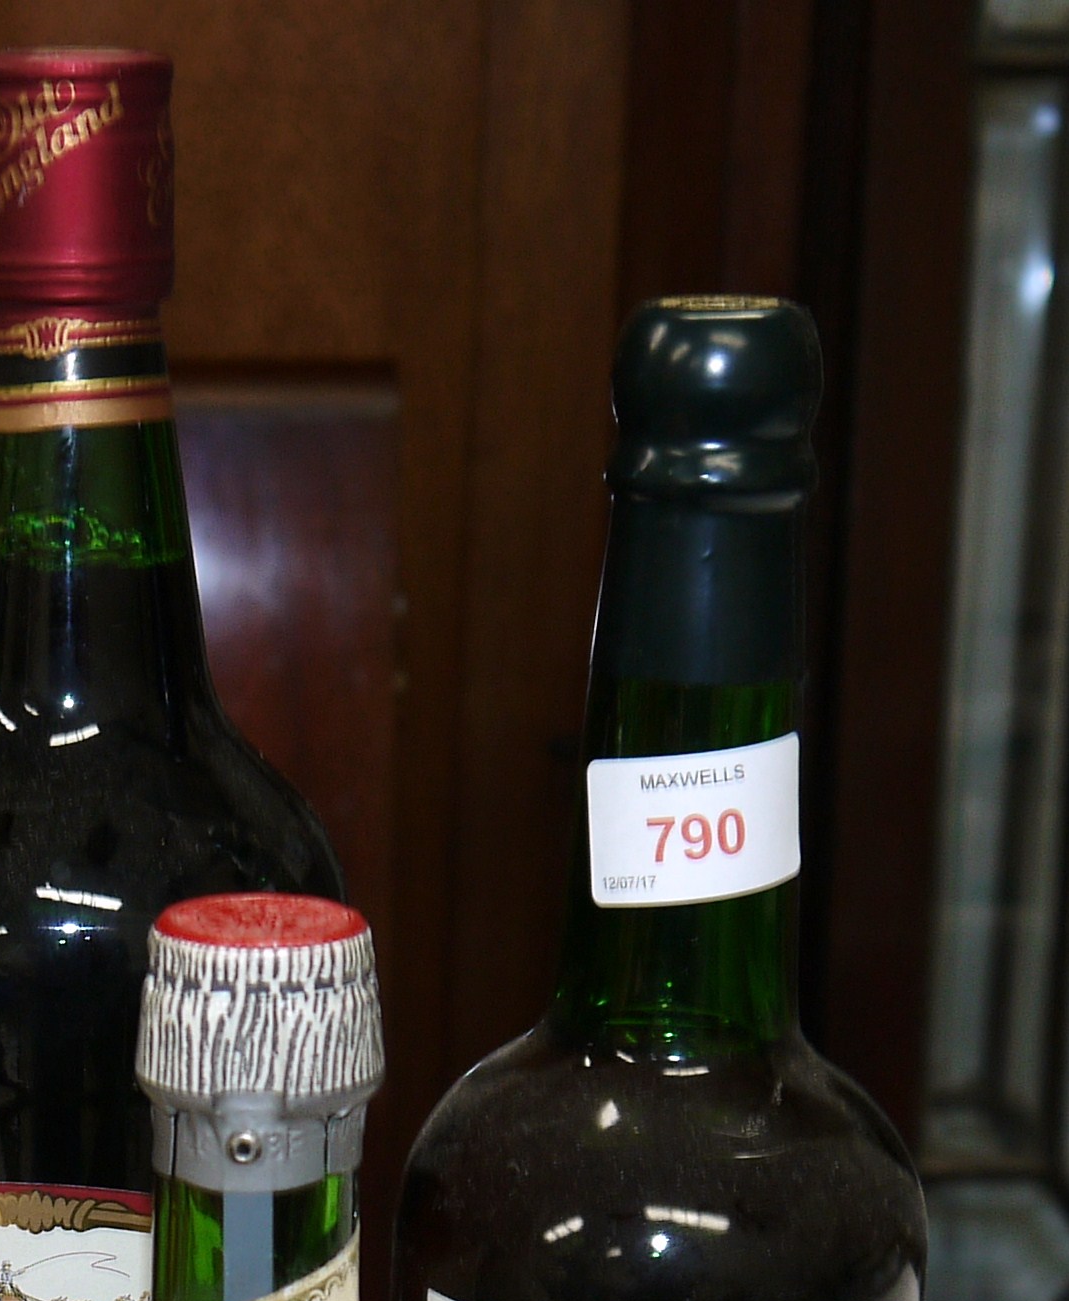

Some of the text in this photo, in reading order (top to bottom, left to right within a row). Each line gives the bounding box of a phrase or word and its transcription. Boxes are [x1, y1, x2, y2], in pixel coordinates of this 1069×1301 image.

[640, 764, 745, 791] MAXWELLS
[646, 808, 746, 863] 790
[602, 875, 656, 890] 12/07/17
